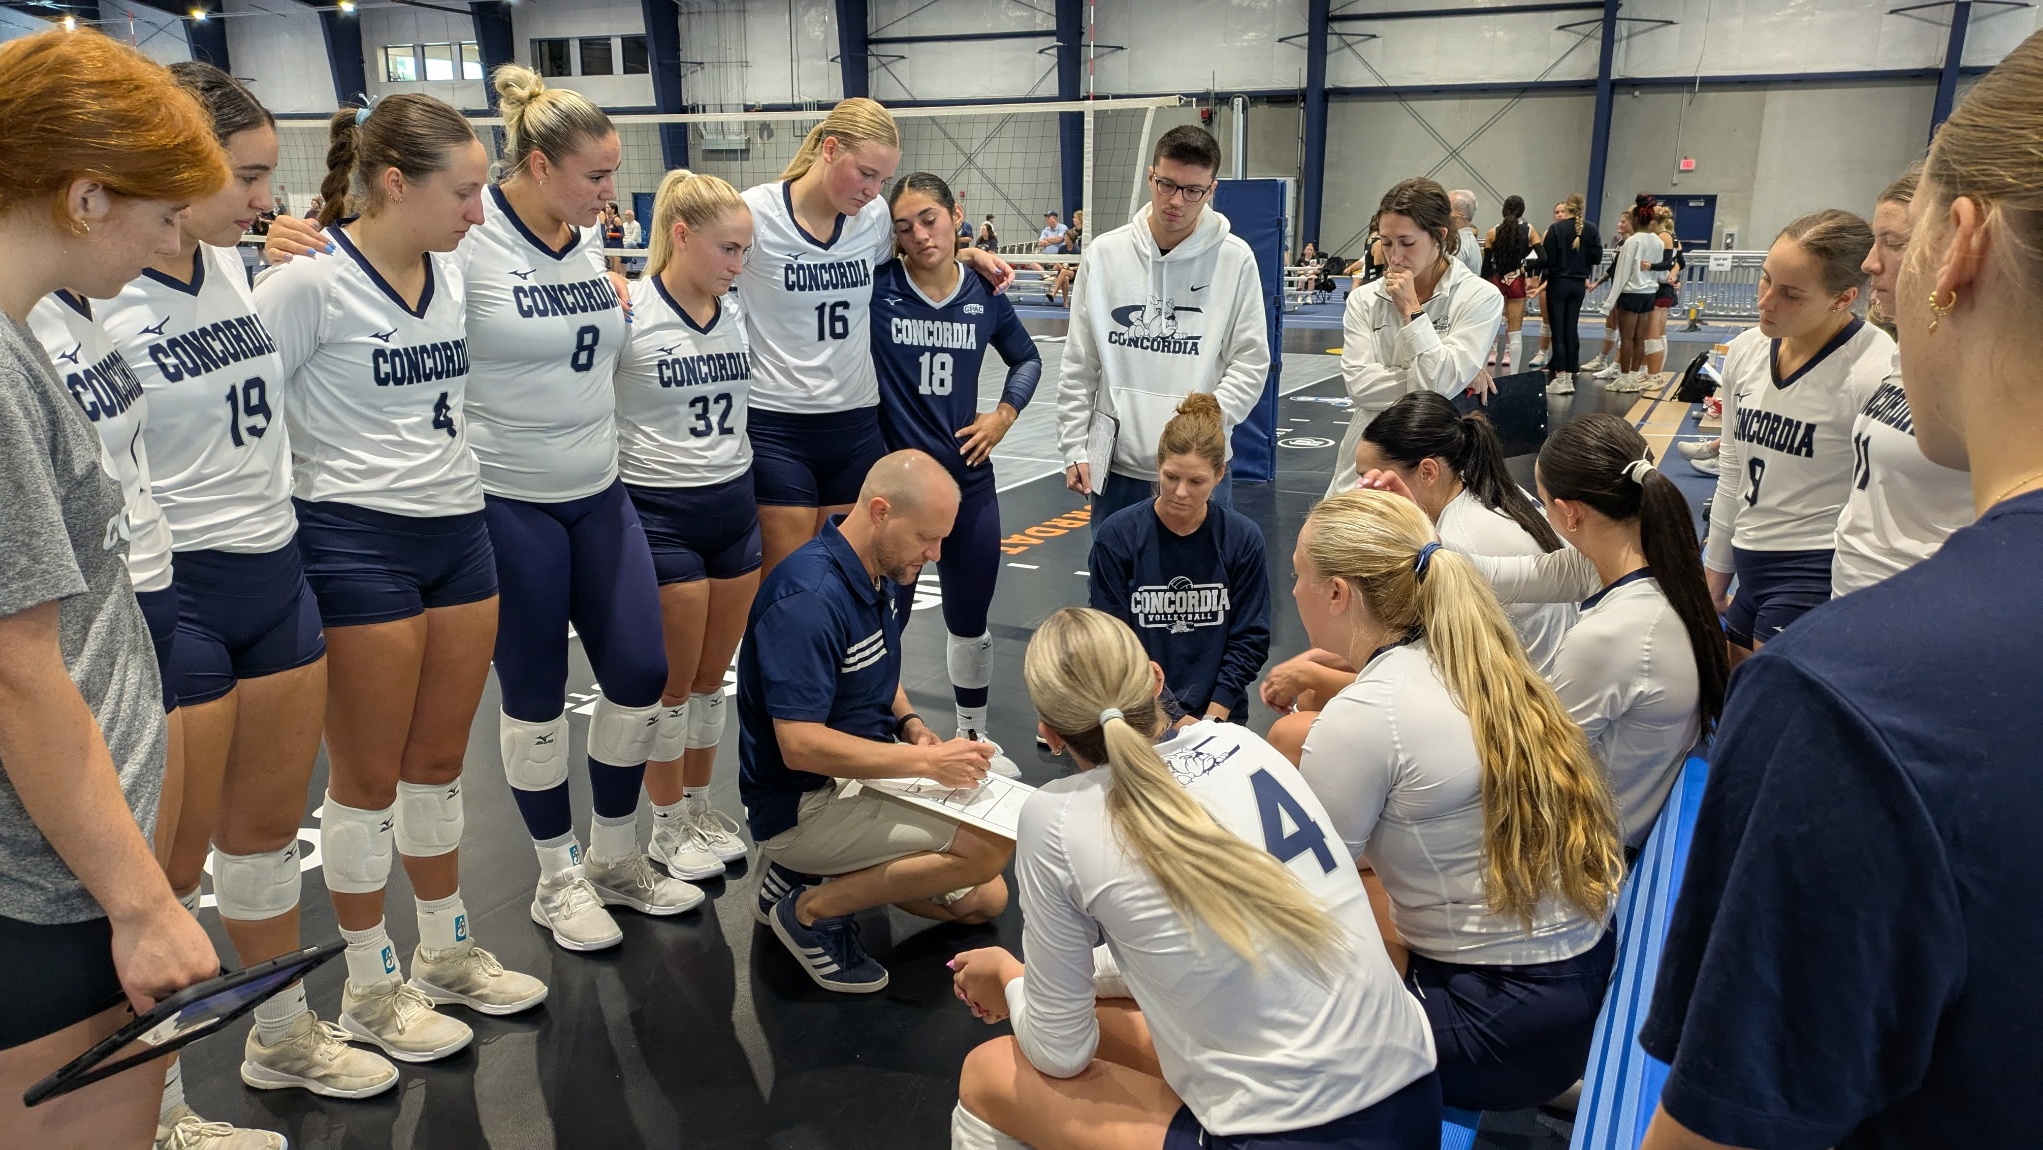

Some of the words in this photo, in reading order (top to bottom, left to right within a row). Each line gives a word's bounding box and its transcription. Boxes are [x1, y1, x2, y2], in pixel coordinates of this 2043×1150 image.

[513, 276, 620, 318] CONCORDIA
[784, 259, 871, 292] CONCORDIA
[814, 300, 851, 342] 16
[964, 304, 984, 314] GPAC
[571, 325, 600, 373] 8
[891, 317, 977, 350] CONCORDIA
[1108, 331, 1200, 355] CONCORDIA
[657, 352, 752, 388] CONCORDIA
[918, 351, 954, 396] 18
[225, 375, 272, 448] 19
[432, 391, 457, 438] 4
[689, 392, 735, 437] 32
[1733, 407, 1817, 458] ONCORDIA
[1744, 456, 1766, 507] 9
[1853, 431, 1872, 491] 11
[1131, 588, 1231, 614] CONCORDIA
[1148, 613, 1213, 622] VOLLEYBALL
[1249, 766, 1340, 877] 4
